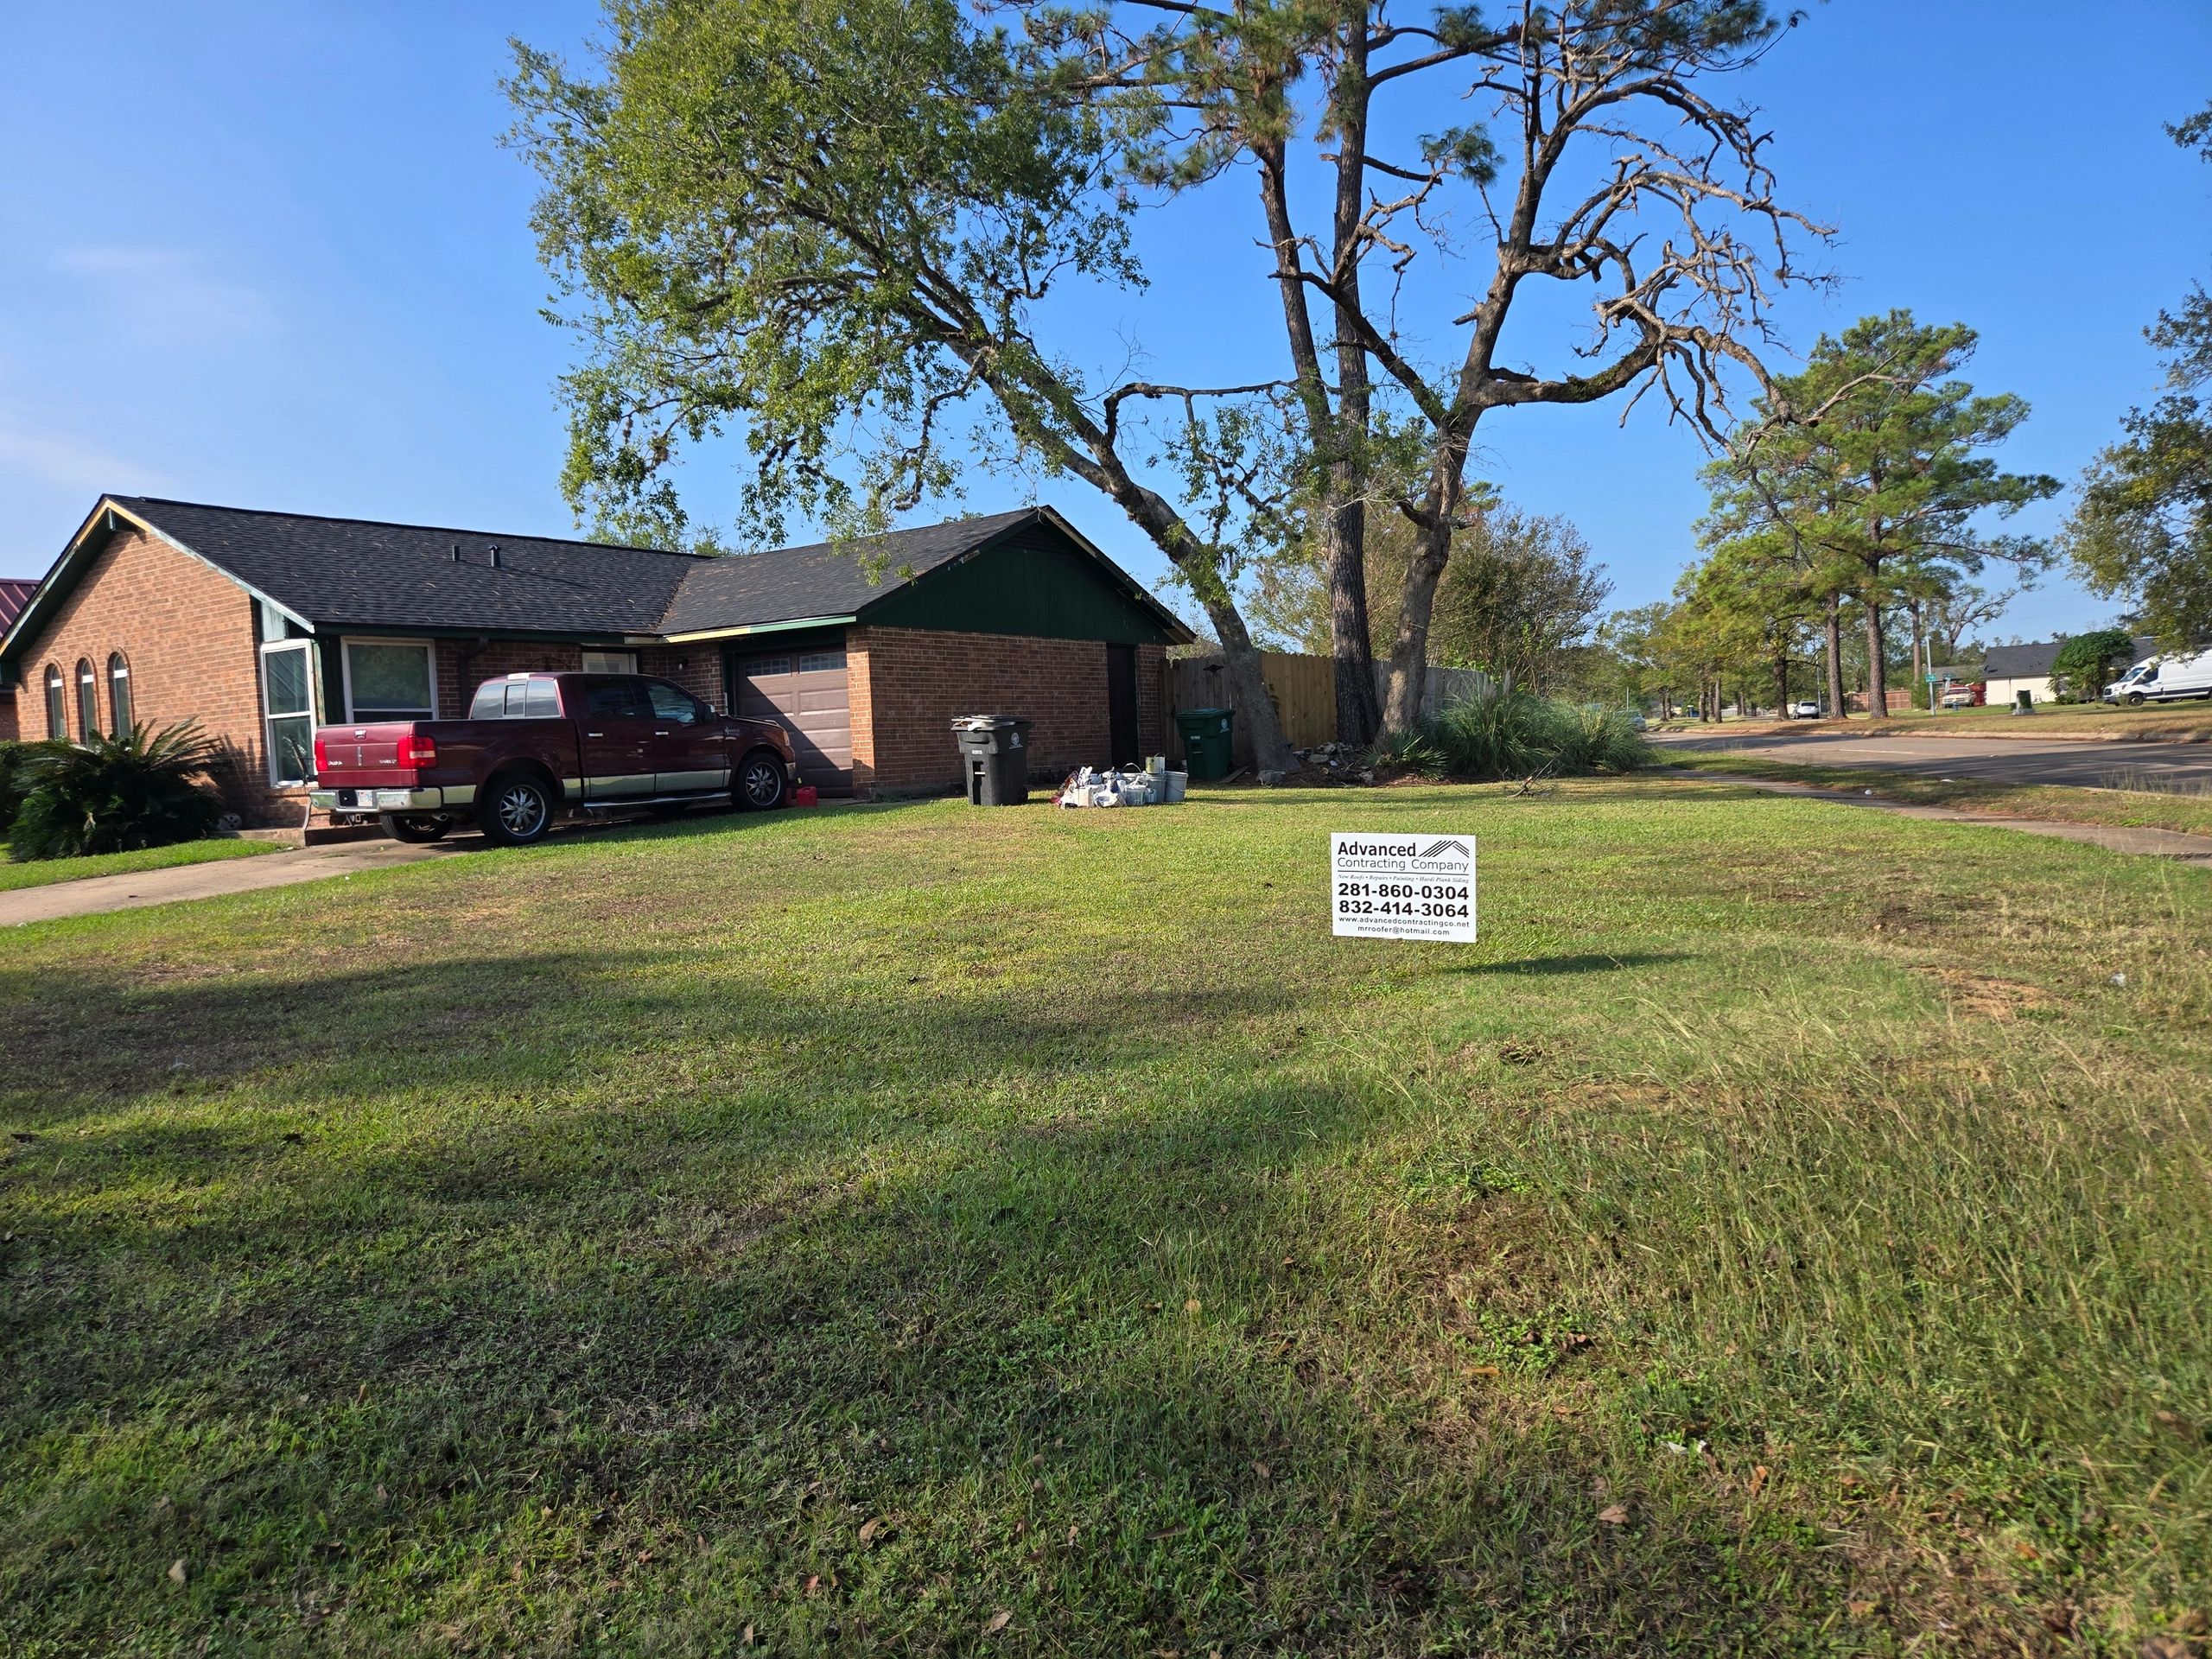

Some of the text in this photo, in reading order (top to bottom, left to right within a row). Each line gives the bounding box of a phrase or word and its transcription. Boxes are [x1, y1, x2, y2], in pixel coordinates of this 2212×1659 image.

[1338, 841, 1416, 857] Advanced
[1338, 858, 1469, 873] Contracting Company
[1338, 882, 1469, 900] 281-860-0304
[1339, 899, 1469, 918] 832-414-3064
[1338, 916, 1470, 928] www.advancedcontractingco.net
[1357, 926, 1450, 936] mrroofer@hotmail.com
